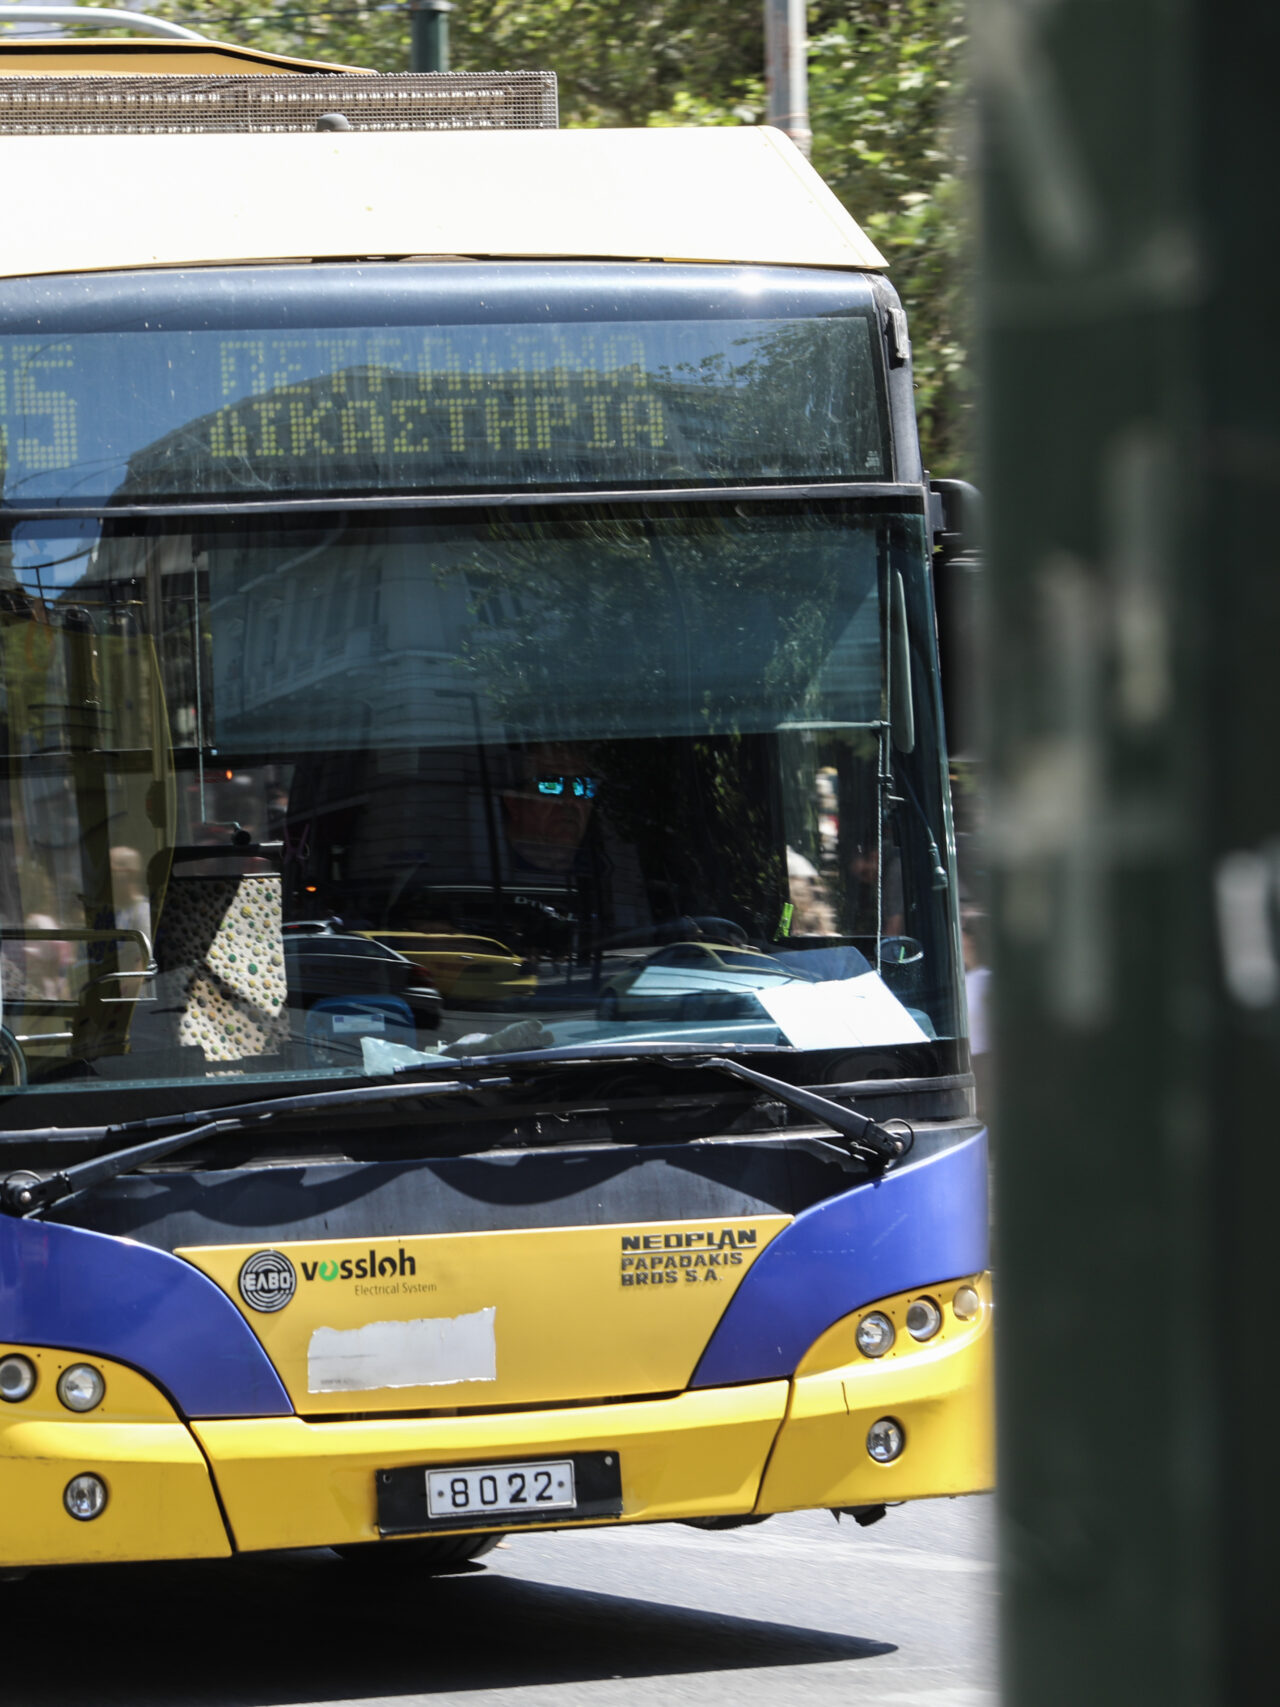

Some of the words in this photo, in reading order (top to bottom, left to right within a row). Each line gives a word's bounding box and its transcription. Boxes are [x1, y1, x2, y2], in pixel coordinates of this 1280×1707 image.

[621, 1228, 757, 1251] NEOPLAN
[301, 1248, 416, 1281] vossloh
[621, 1252, 743, 1271] PAPADAKIS
[355, 1283, 400, 1296] Electrical
[402, 1281, 438, 1294] System
[621, 1270, 678, 1287] BROS
[450, 1471, 554, 1508] 8022
